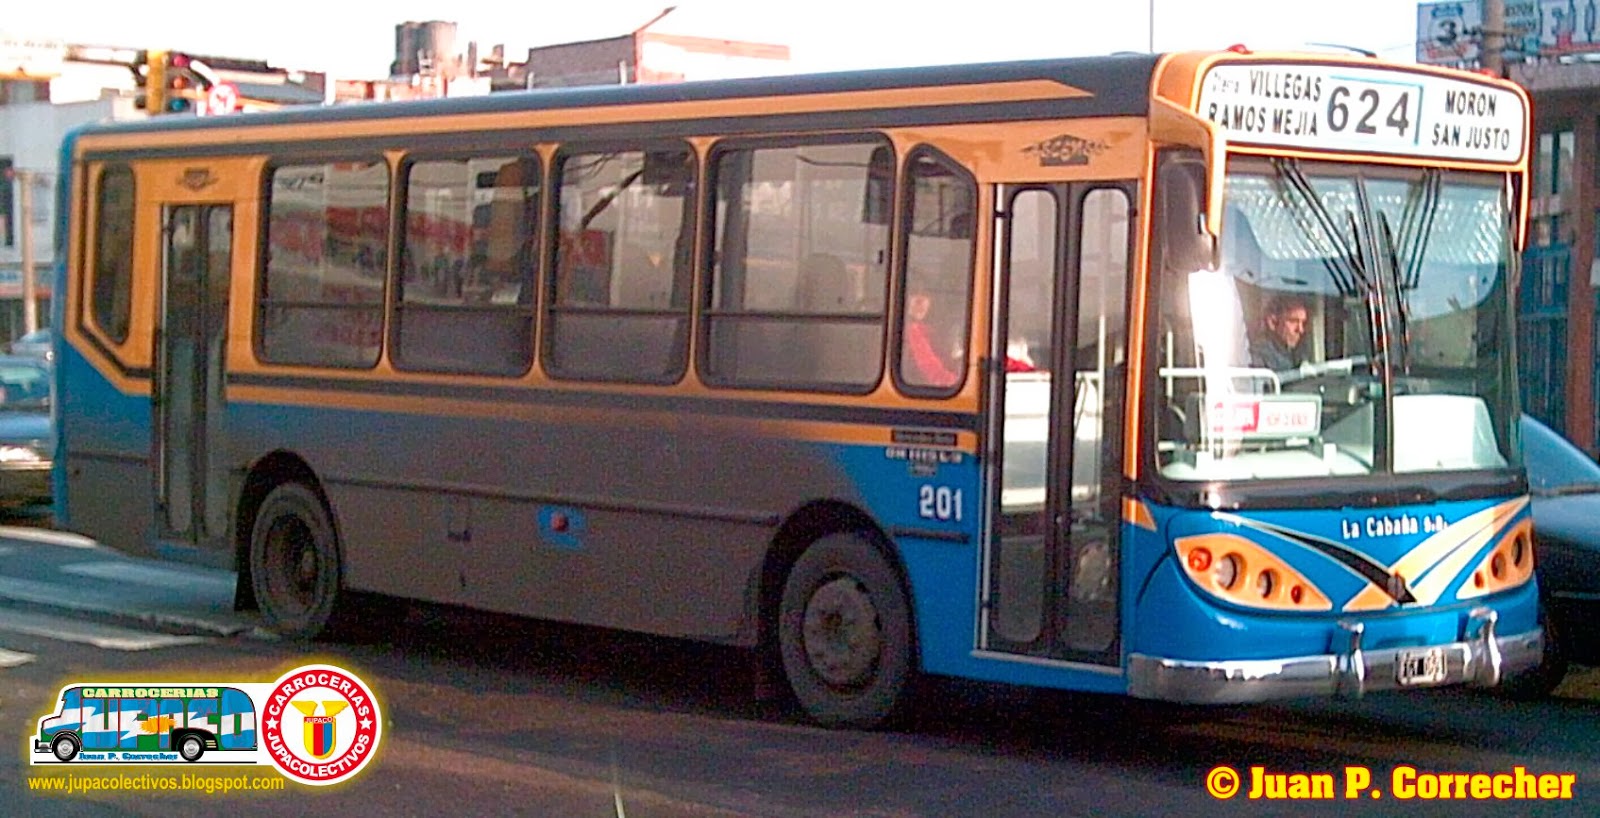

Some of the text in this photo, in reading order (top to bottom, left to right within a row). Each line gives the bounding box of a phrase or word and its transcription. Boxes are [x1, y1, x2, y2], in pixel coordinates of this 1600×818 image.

[1250, 69, 1322, 102] VILLEGAS
[1208, 102, 1318, 136] RAMOS MEJIA
[1327, 85, 1410, 137] 624
[1445, 90, 1497, 118] MORON
[1432, 122, 1510, 151] SAN JUSTO
[920, 484, 962, 521] 201
[1342, 519, 1360, 540] La
[1366, 514, 1419, 538] Cabaña
